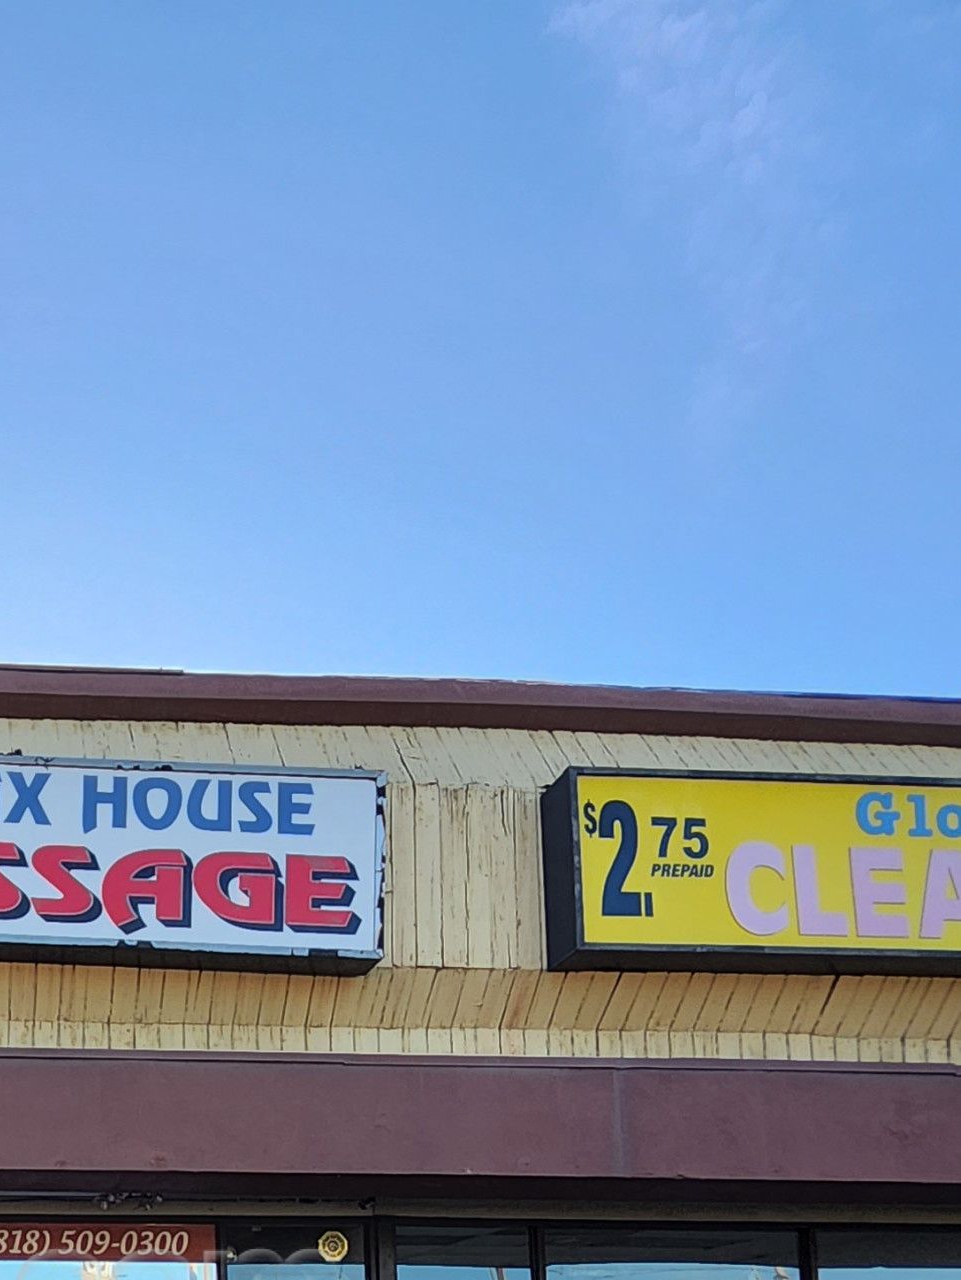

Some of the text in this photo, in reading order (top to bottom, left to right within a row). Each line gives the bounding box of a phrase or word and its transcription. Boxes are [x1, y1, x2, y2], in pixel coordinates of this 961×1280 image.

[82, 774, 316, 836] HOUSE
[650, 863, 714, 878] PREPAID
[57, 1229, 189, 1256] 509-0300
